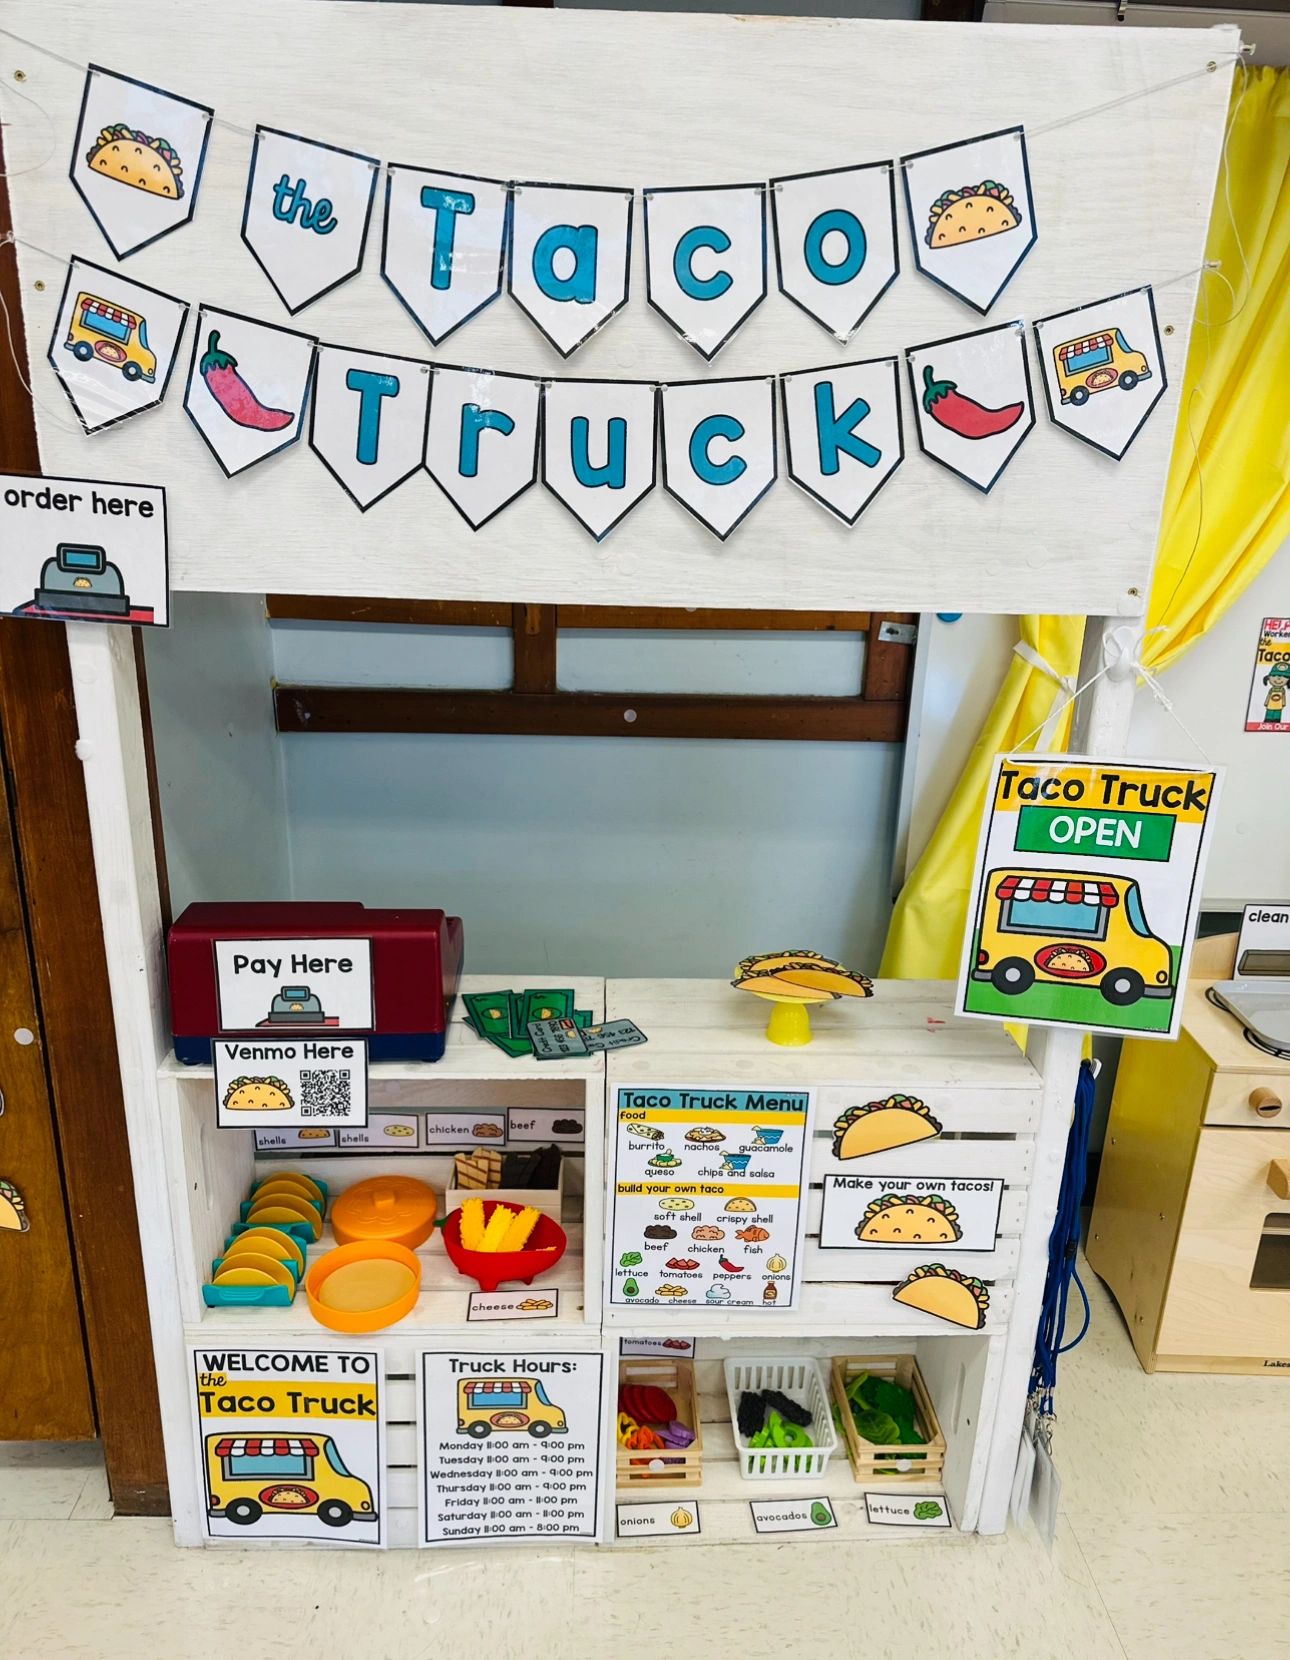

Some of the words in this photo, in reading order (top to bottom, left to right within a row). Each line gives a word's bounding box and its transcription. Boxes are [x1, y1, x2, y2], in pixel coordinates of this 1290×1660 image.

[272, 174, 338, 235] the
[420, 186, 868, 305] Taco
[345, 368, 882, 491] Truck
[4, 487, 83, 512] order
[92, 491, 154, 518] here
[1259, 649, 1290, 662] Taco
[1001, 770, 1085, 802] Taco
[1100, 774, 1206, 811] Truck
[1050, 815, 1142, 849] OPEN
[1248, 910, 1289, 923] clean
[233, 954, 282, 978] Pay
[291, 954, 353, 973] Here
[225, 1044, 296, 1060] Venmo
[303, 1043, 354, 1059] Here
[624, 1092, 671, 1108] Taco
[680, 1093, 738, 1110] Truck
[745, 1094, 803, 1111] Menu
[620, 1111, 646, 1120] food
[429, 1124, 470, 1135] chicken
[510, 1120, 537, 1131] beef
[258, 1136, 286, 1146] shells
[341, 1133, 369, 1144] shells
[629, 1140, 665, 1150] burrito
[684, 1142, 720, 1151] nachos
[739, 1143, 793, 1153] guacamole
[645, 1168, 674, 1178] queso
[698, 1167, 723, 1178] chips
[727, 1168, 746, 1177] and
[749, 1169, 775, 1178] salsa
[618, 1184, 642, 1193] build
[646, 1185, 671, 1195] your
[675, 1185, 696, 1193] own
[700, 1185, 724, 1194] taco
[833, 1177, 873, 1190] Make
[878, 1180, 911, 1192] your
[916, 1181, 946, 1191] own
[950, 1180, 994, 1192] tacos!
[654, 1212, 676, 1221] soft
[679, 1212, 702, 1222] shell
[716, 1214, 748, 1225] crispy
[751, 1214, 774, 1223] shell
[644, 1242, 669, 1251] beef
[687, 1244, 725, 1253] chicken
[743, 1245, 763, 1254] fish
[615, 1268, 649, 1277] lettuce
[659, 1269, 703, 1279] tomatoes
[712, 1271, 752, 1280] peppers
[762, 1272, 791, 1280] onions
[625, 1296, 660, 1304] avocado
[472, 1301, 514, 1312] cheese
[624, 1338, 662, 1346] tomatoes
[202, 1353, 329, 1373] WELCOME
[338, 1355, 370, 1374] TO
[449, 1358, 505, 1374] Truck
[513, 1358, 577, 1374] Hours:
[200, 1373, 227, 1387] the
[200, 1391, 275, 1413] Taco
[286, 1391, 377, 1416] Truck
[439, 1442, 483, 1452] Monday
[568, 1442, 585, 1451] pm
[439, 1456, 483, 1466] Tuesday
[568, 1456, 585, 1465] pm
[430, 1470, 492, 1480] Wednesday
[576, 1470, 593, 1479] pm
[437, 1484, 486, 1493] Thursday
[570, 1484, 586, 1492] pm
[445, 1498, 480, 1507] Friday
[561, 1498, 577, 1506] pm
[869, 1503, 910, 1515] lettuce
[438, 1512, 487, 1522] Saturday
[568, 1511, 584, 1520] pm
[620, 1516, 655, 1525] onions
[756, 1511, 807, 1522] avocados
[443, 1526, 480, 1536] Sunday
[563, 1525, 579, 1533] pm
